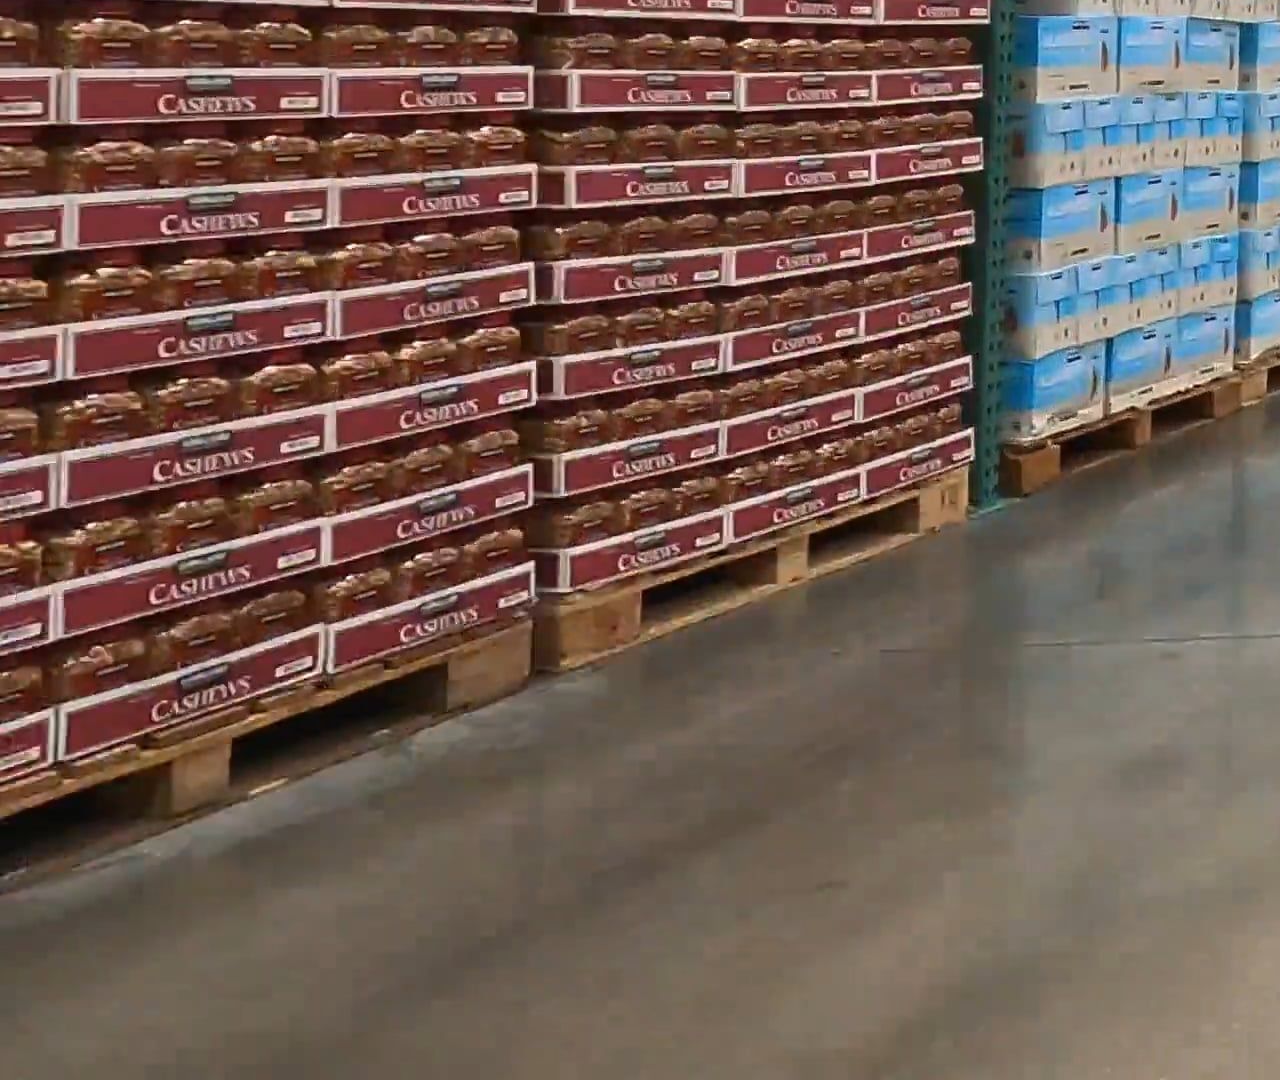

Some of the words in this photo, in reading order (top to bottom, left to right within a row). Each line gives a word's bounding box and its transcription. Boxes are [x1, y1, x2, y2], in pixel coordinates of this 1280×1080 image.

[157, 94, 256, 113] CASHEWS
[400, 91, 476, 110] CASHEWS
[402, 193, 480, 215] CASHEWS
[160, 211, 259, 235] CASHEWS
[403, 295, 480, 322] CASHEWS
[157, 329, 257, 359] CASHEWS
[400, 399, 478, 430] CASHEWS
[153, 447, 254, 482] CASHEWS
[397, 505, 475, 539] CASHEWS
[149, 564, 251, 605] CASHEWS
[400, 608, 478, 643] CASHEWS
[151, 676, 251, 722] CASHEWS
